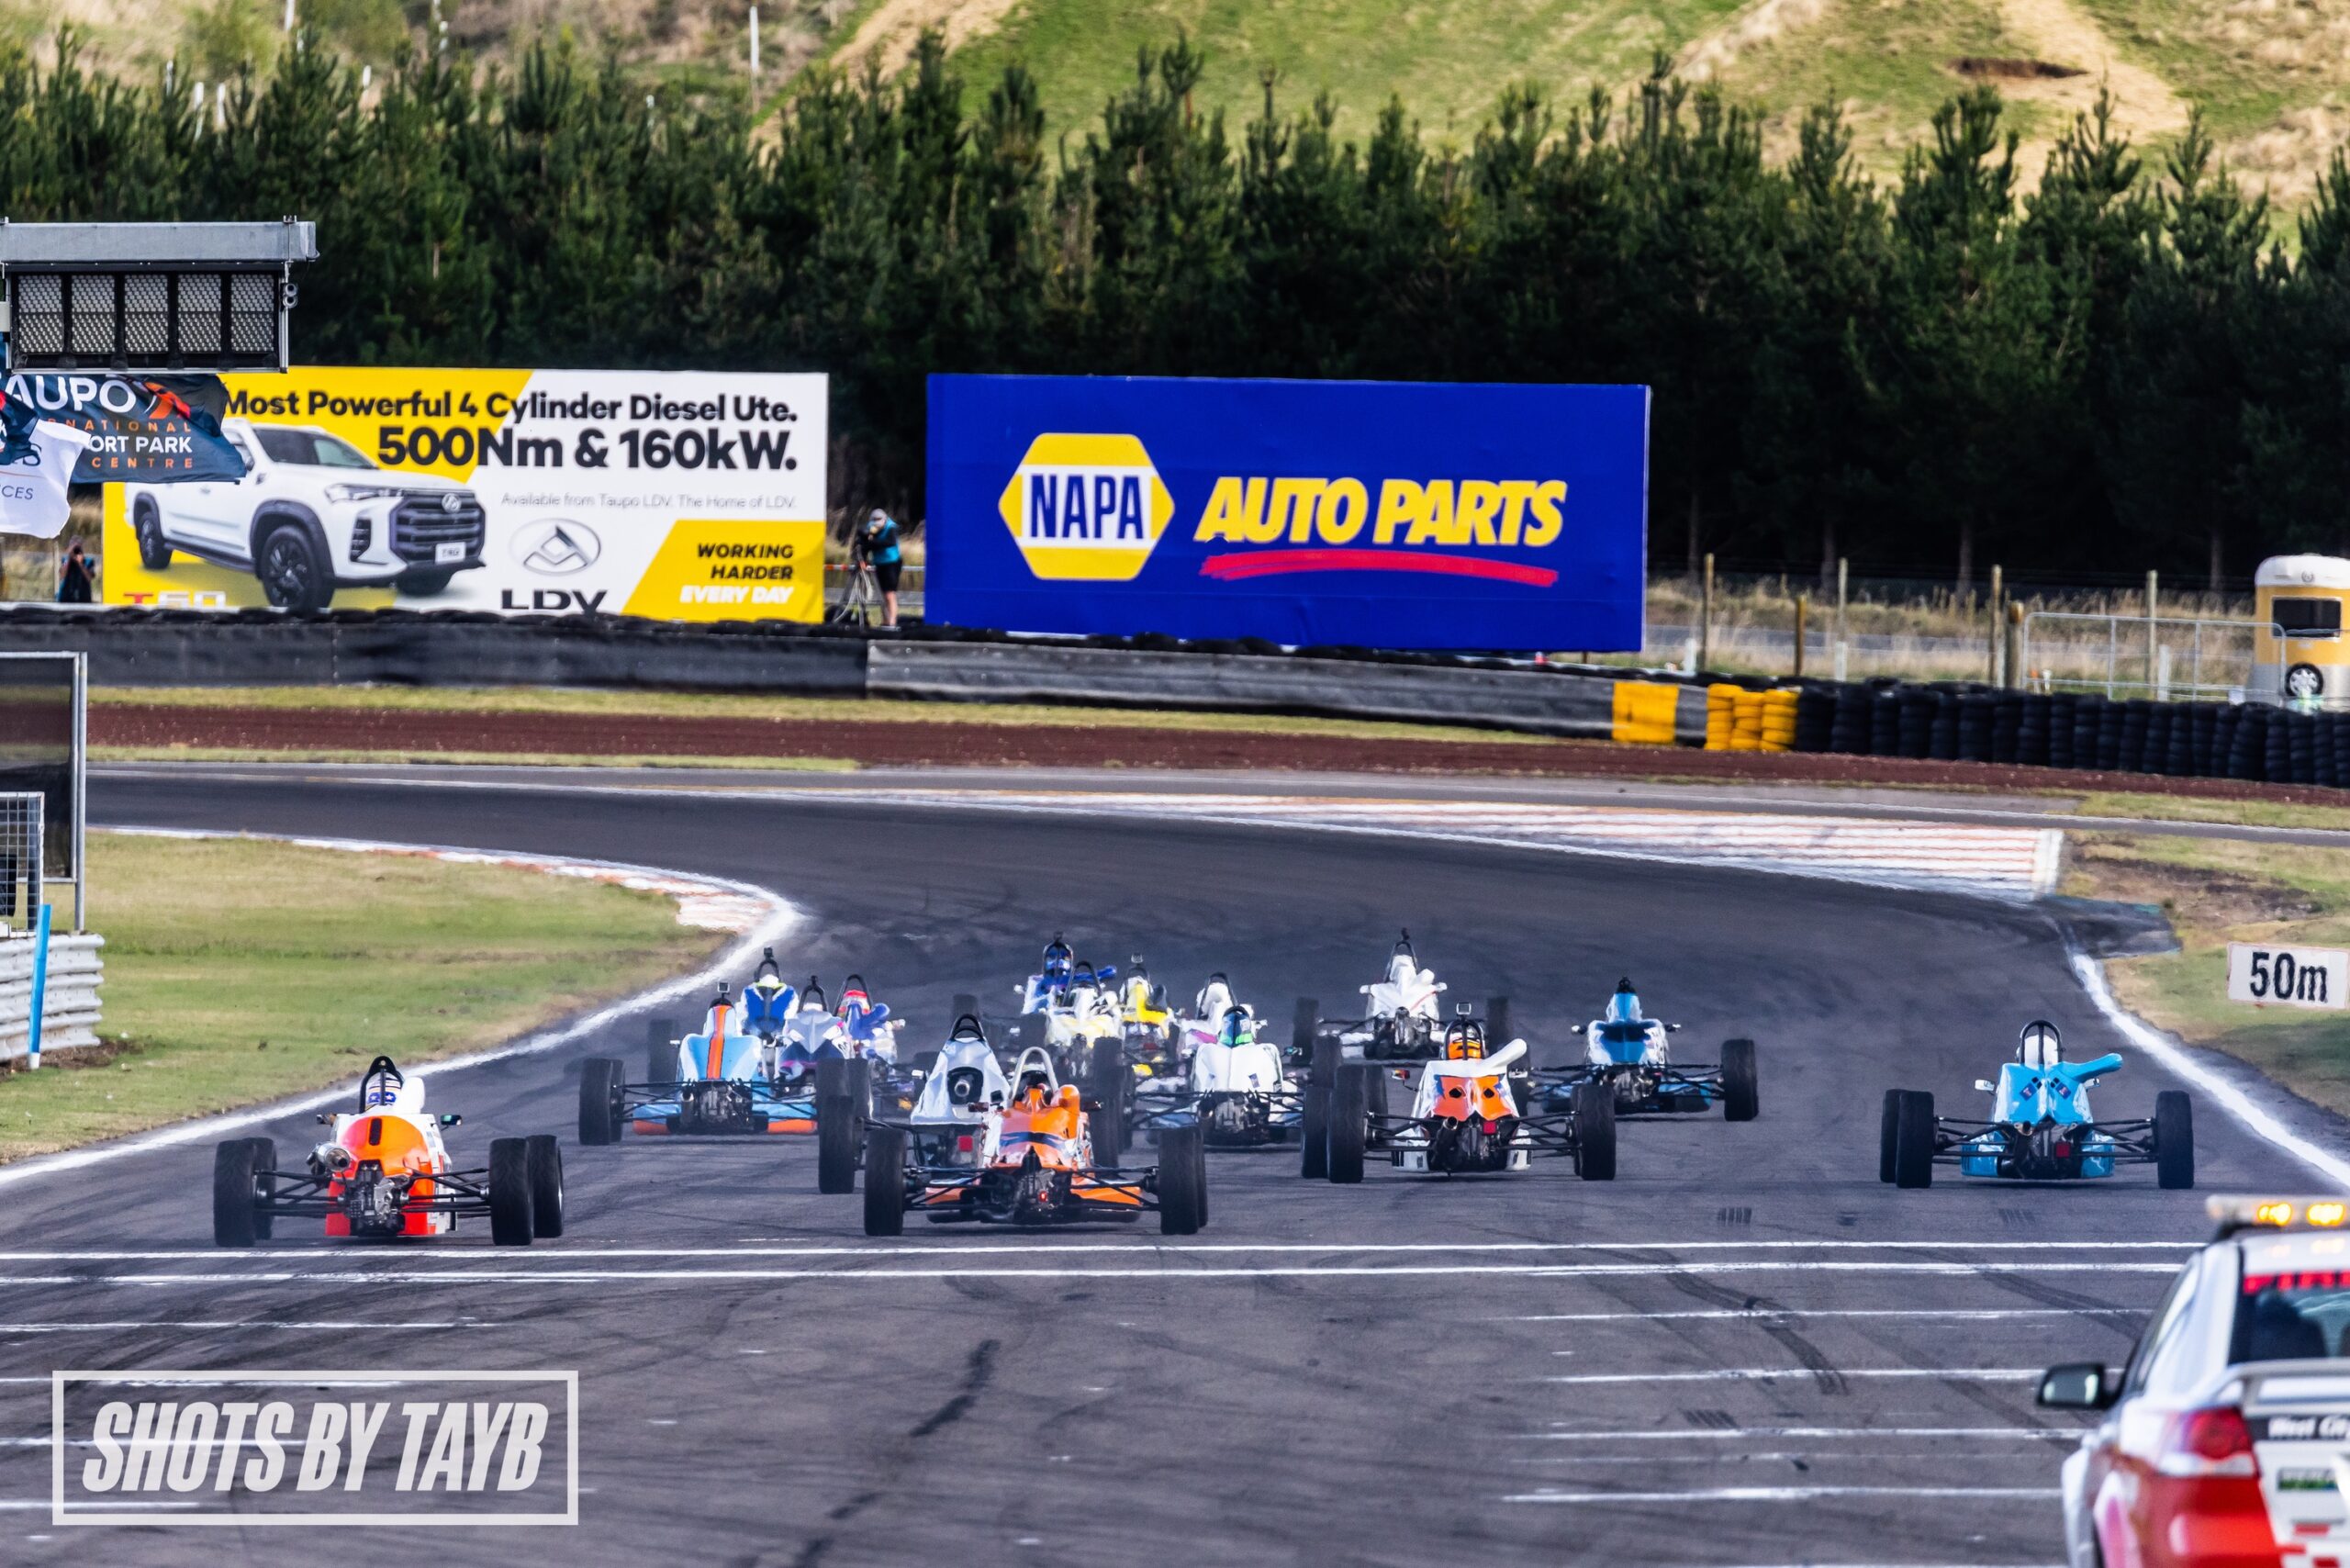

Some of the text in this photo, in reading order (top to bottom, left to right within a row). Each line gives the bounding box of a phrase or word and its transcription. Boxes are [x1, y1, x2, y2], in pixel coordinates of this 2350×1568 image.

[227, 390, 797, 424] Most Powerful 4 Cylinder Diesel Ute.
[136, 436, 193, 453] PARK
[377, 426, 797, 470] 500Nm & 160kW.
[92, 457, 193, 469] CENTRE
[0, 485, 34, 500] CES
[501, 492, 560, 506] Available
[564, 492, 596, 506] from
[677, 494, 703, 508] The
[706, 495, 746, 508] Home
[749, 495, 764, 508] of
[1030, 474, 1144, 540] NAPA
[1194, 477, 1568, 546] AUTO PARTS
[698, 543, 793, 559] WORKING
[711, 566, 793, 580] HARDER
[501, 589, 608, 612] LDV
[679, 585, 794, 604] EVERY DAY
[2250, 951, 2328, 1002] 50m
